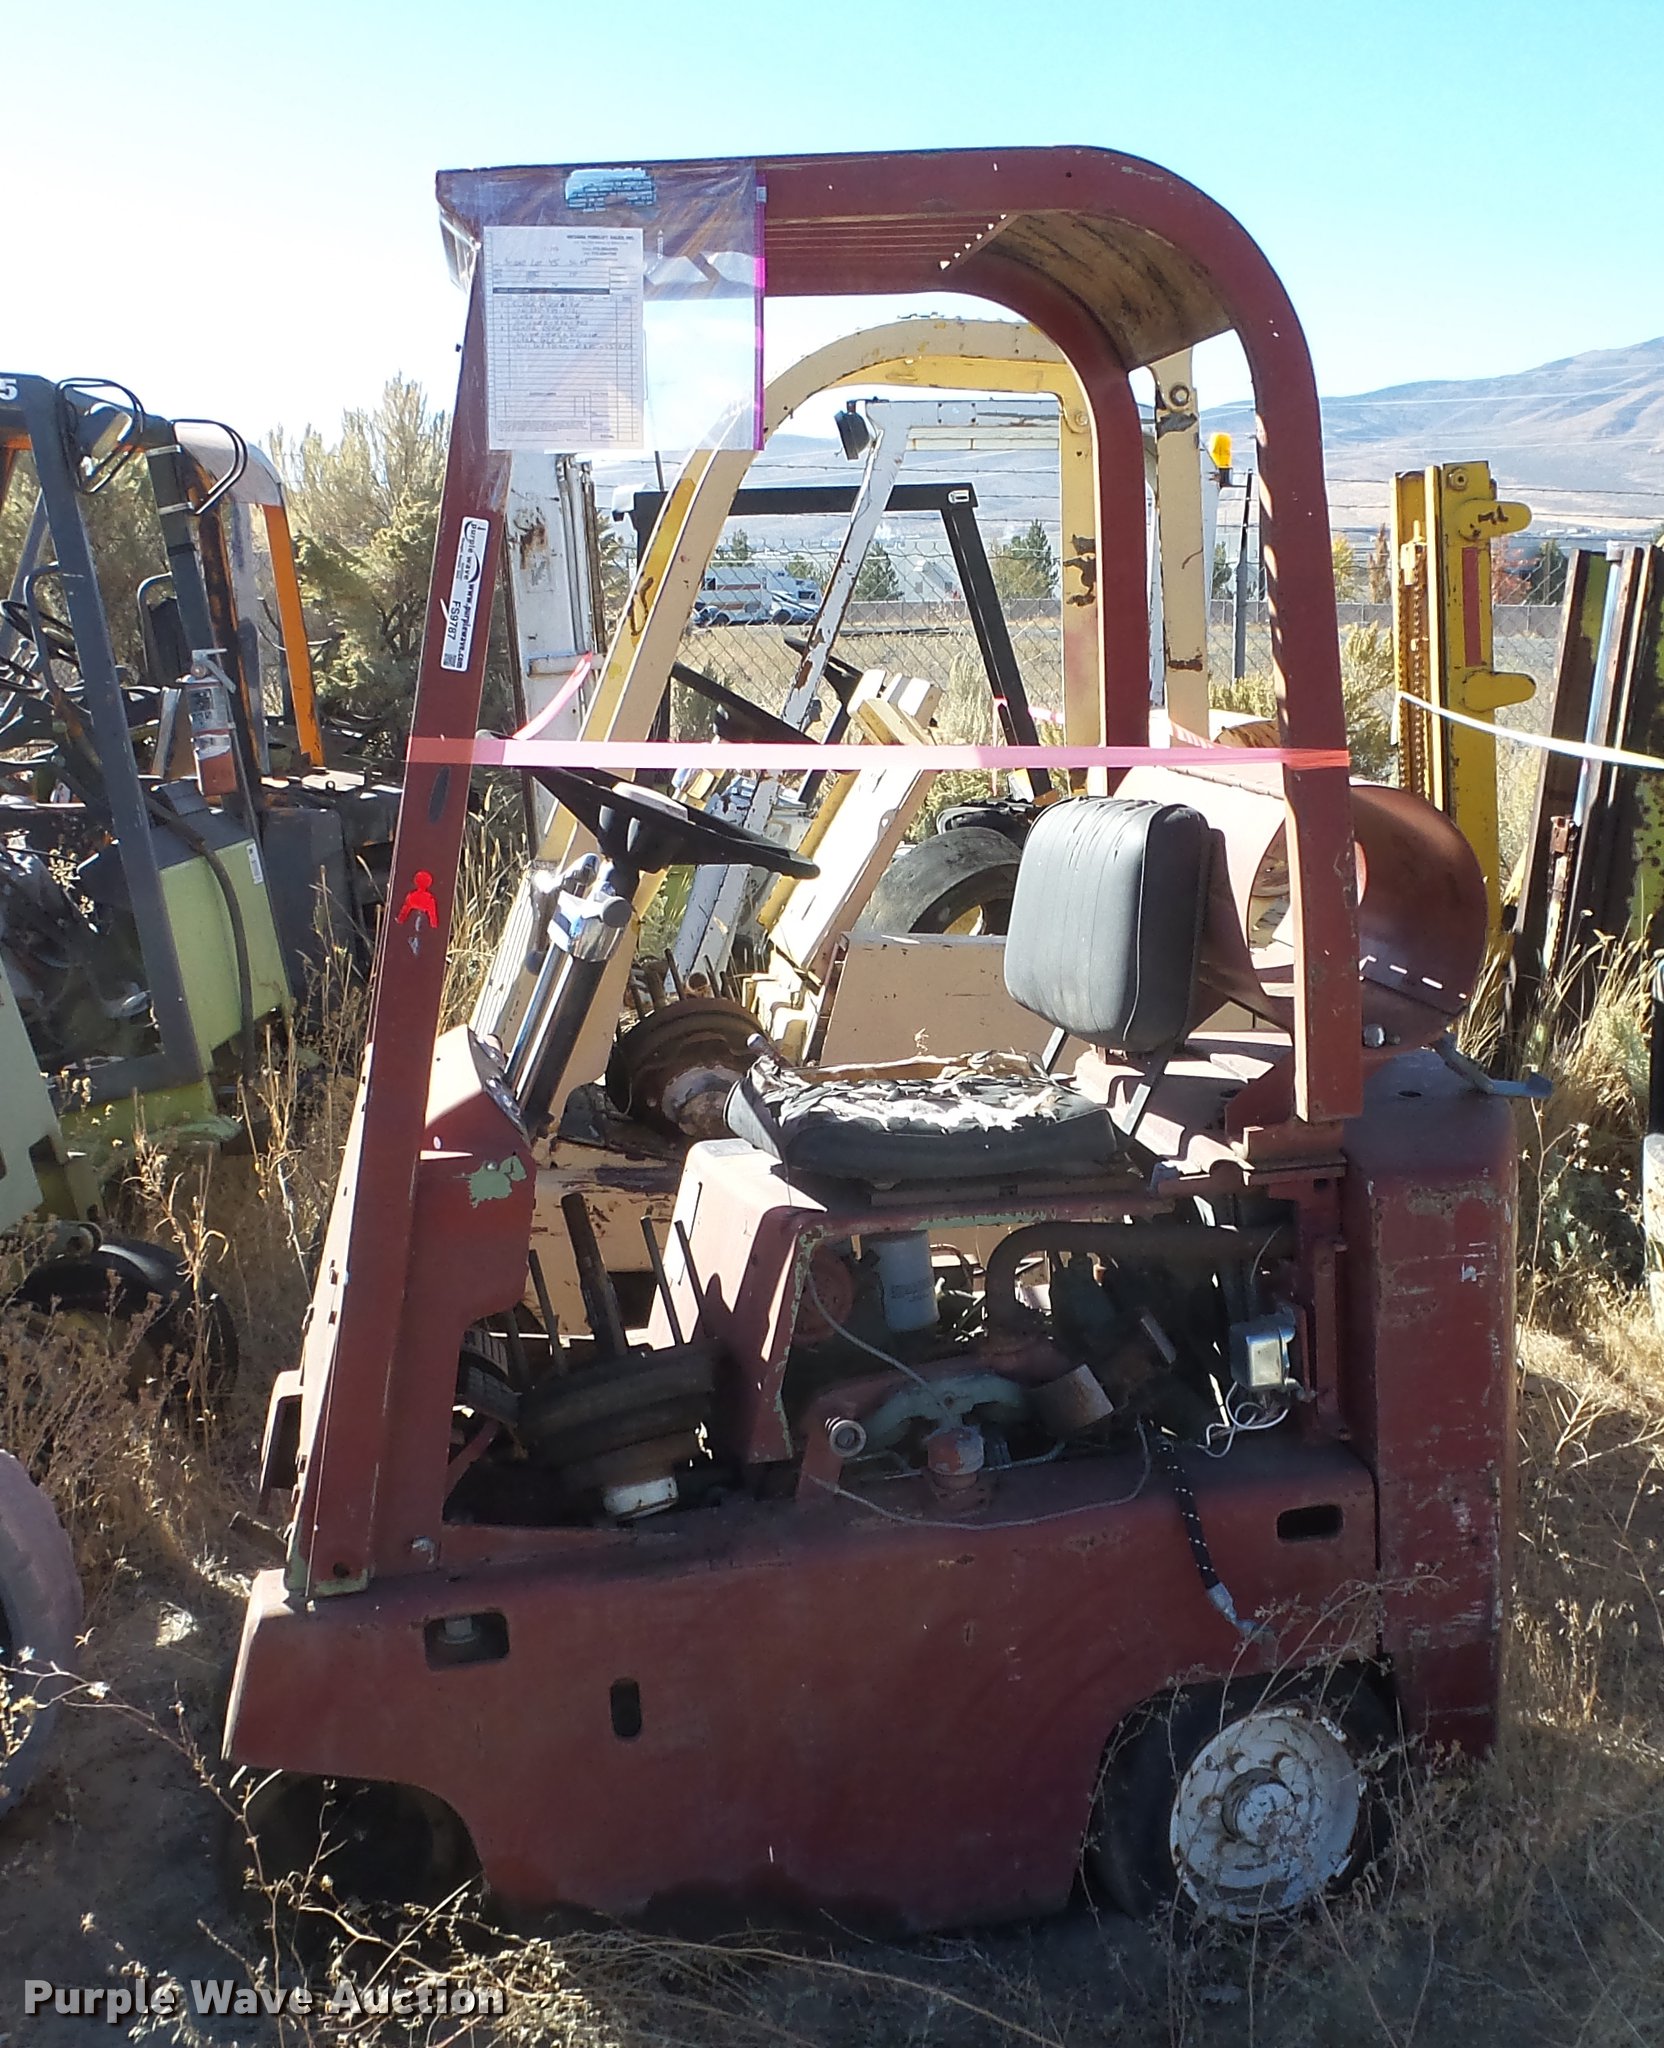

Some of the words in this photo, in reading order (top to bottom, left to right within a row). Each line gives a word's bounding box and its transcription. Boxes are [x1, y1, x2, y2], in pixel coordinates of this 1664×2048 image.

[0, 378, 18, 401] 5
[468, 523, 477, 554] purple
[463, 556, 473, 581] wave
[447, 600, 461, 641] FS9787
[456, 583, 475, 669] www.purplewave.com
